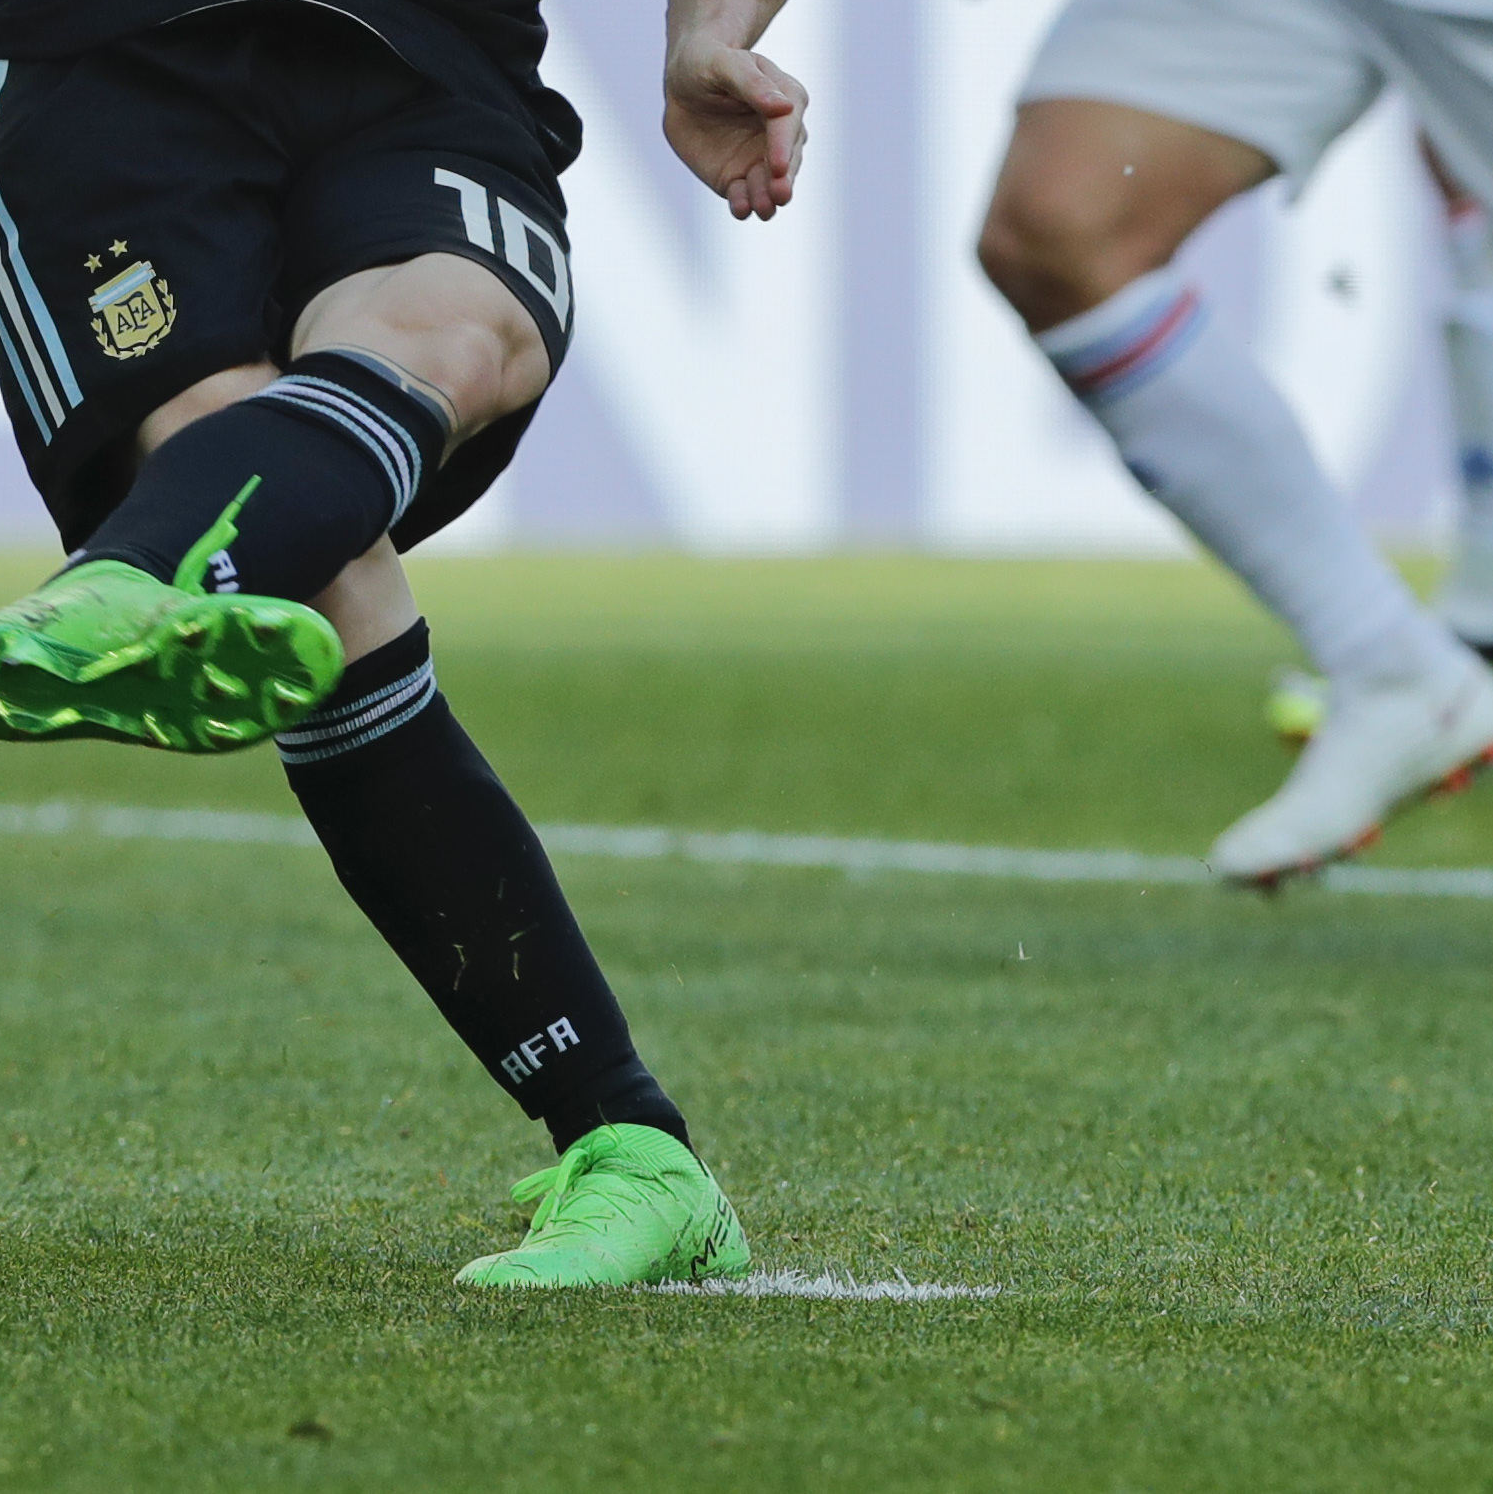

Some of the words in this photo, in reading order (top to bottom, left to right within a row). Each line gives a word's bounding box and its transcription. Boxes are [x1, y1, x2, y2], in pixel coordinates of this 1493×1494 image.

[434, 167, 570, 333] 10
[114, 290, 157, 335] AFA
[501, 1016, 580, 1084] AFA
